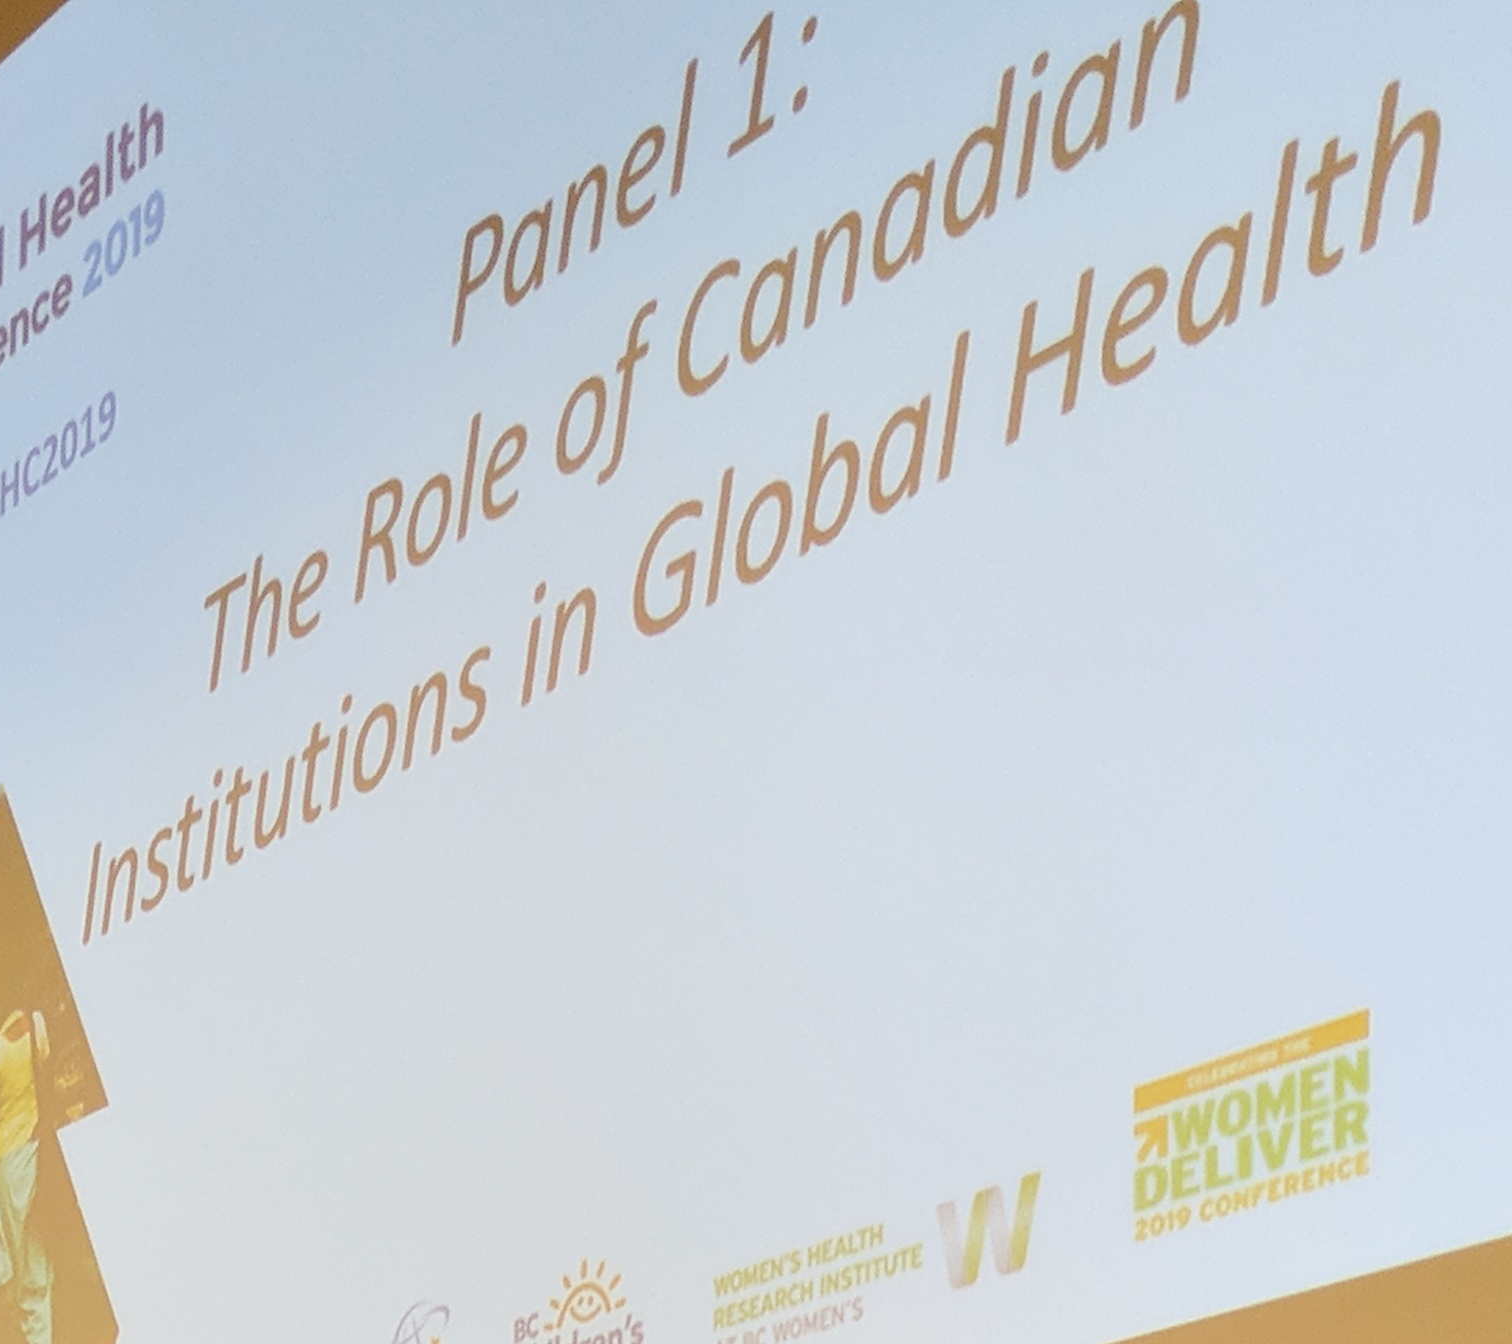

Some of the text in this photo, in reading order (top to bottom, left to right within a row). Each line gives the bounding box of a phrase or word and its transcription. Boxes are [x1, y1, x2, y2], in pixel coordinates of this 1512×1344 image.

[17, 102, 165, 272] Health
[451, 10, 818, 346] Panel 1:
[82, 190, 166, 296] 2019
[204, 0, 1200, 692] The Role of Canadian
[83, 80, 1441, 944] Institutions in Global Health
[1172, 1048, 1370, 1149] WOMEN
[1135, 1101, 1369, 1212] DELIVER
[1135, 1150, 1370, 1242] 2019 CONFERENCE
[713, 1221, 884, 1298] WOMEN'S HEALTH
[713, 1242, 923, 1330] RESEARCH INSTITUTE
[514, 1312, 539, 1344] BC
[773, 1295, 864, 1344] WOMEN'S
